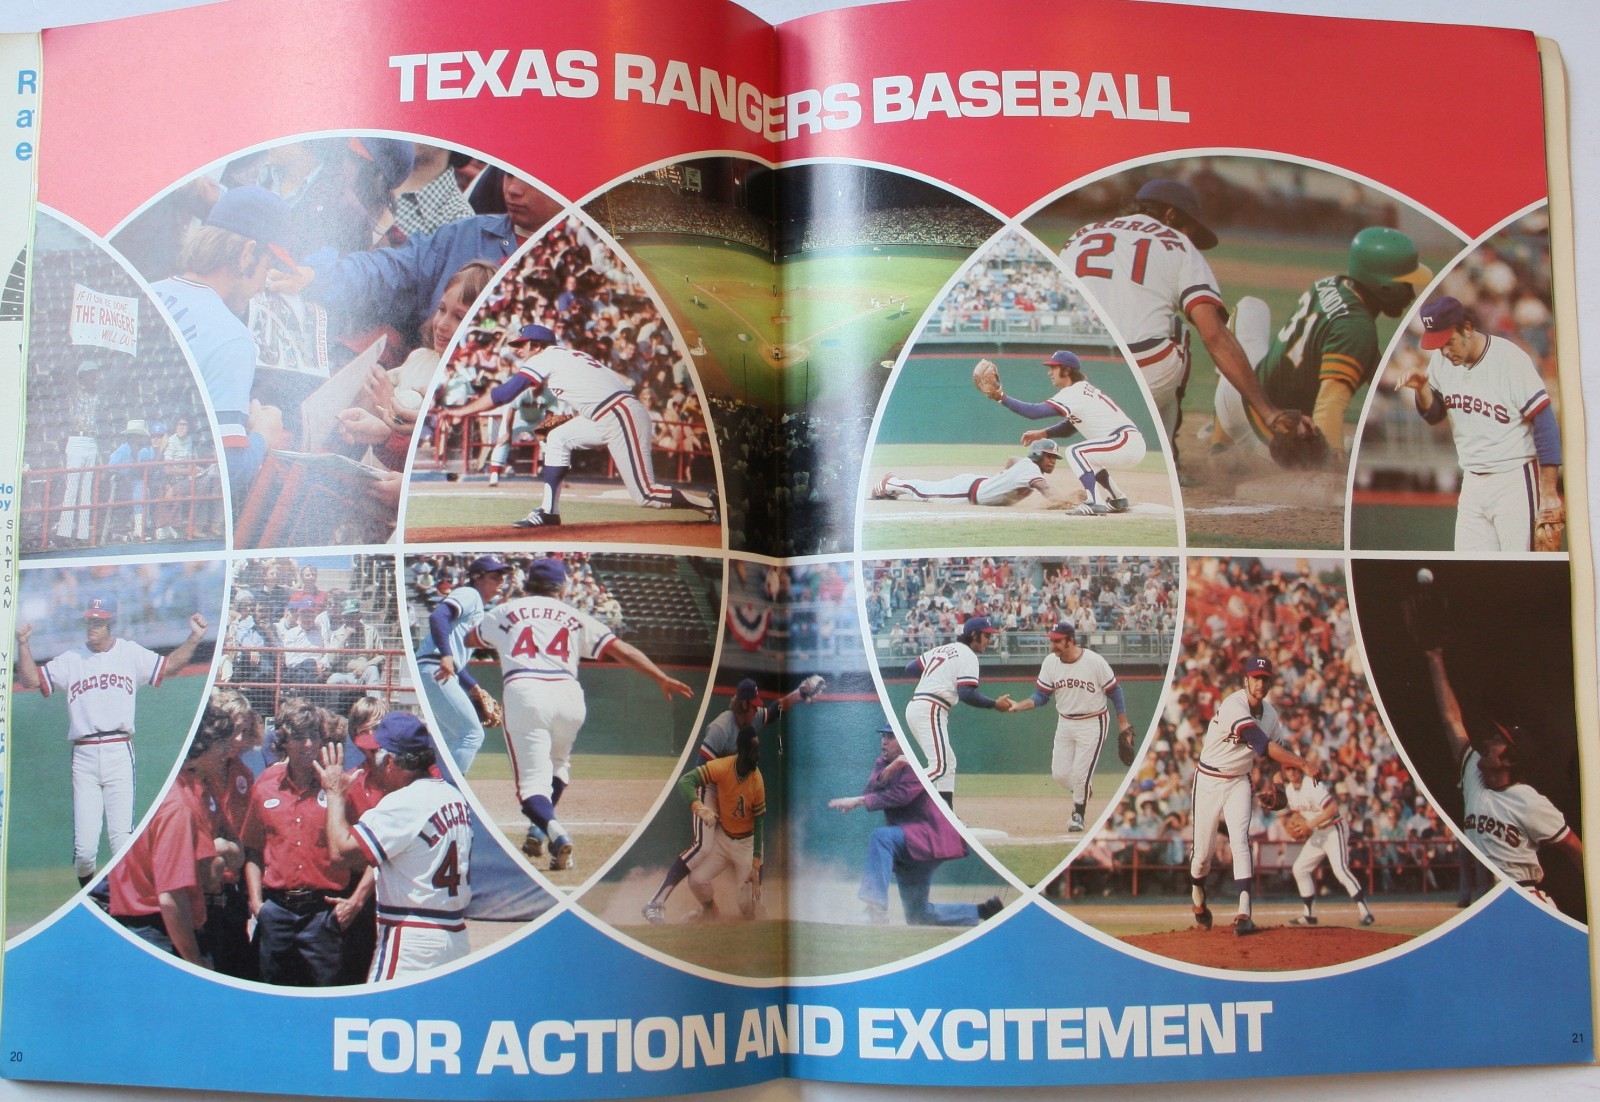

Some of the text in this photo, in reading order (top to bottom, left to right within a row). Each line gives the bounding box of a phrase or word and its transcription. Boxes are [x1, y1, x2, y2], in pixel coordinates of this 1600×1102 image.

[389, 49, 1190, 143] TEXAS RANGERS BASEBALL
[1075, 232, 1152, 286] 21
[75, 304, 96, 324] THE
[98, 307, 135, 336] RANGERS
[1422, 316, 1433, 329] T
[1444, 393, 1511, 424] angers
[93, 598, 102, 609] T
[499, 607, 583, 634] LUCCHESI
[511, 626, 570, 664] 44
[922, 655, 946, 678] 17
[1256, 659, 1266, 668] T
[69, 673, 134, 704] Rangers
[732, 794, 746, 819] A
[431, 840, 471, 898] 4
[333, 1001, 1273, 1076] FOR ACTION AND EXCITEMENT
[1572, 1032, 1584, 1044] 21
[10, 1051, 23, 1062] 20
